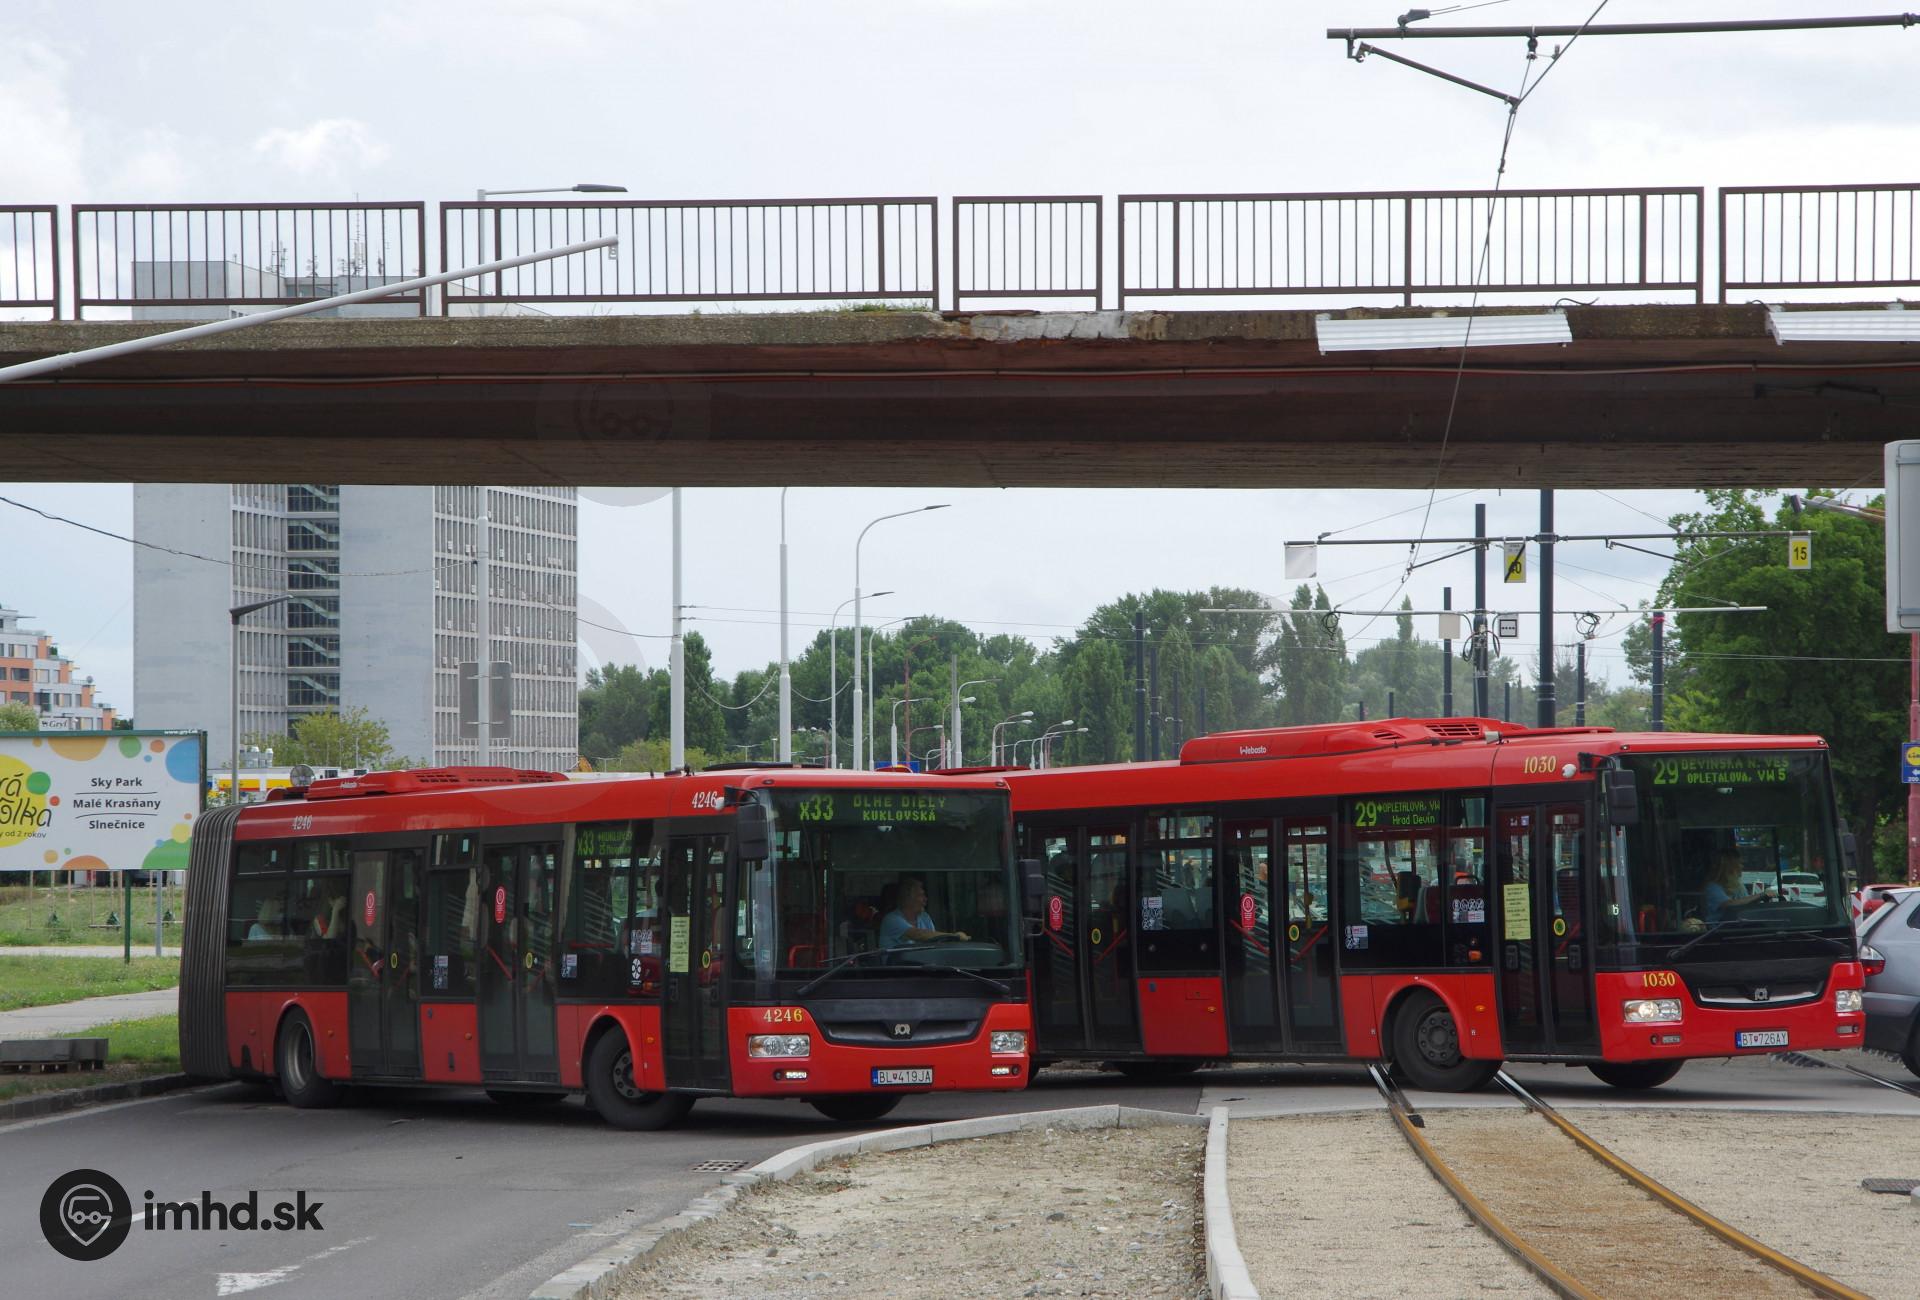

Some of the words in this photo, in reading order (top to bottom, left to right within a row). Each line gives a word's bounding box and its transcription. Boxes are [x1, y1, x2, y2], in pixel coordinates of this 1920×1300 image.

[1793, 546, 1808, 561] 15
[1524, 755, 1557, 774] 1030
[1654, 759, 1679, 785] 29
[90, 777, 112, 789] Sky
[115, 777, 143, 787] Park
[73, 799, 102, 808] Malé
[105, 798, 161, 810] Krasňany
[691, 791, 718, 809] 4246
[1355, 801, 1377, 827] 29
[1392, 814, 1411, 825] Hrad
[88, 820, 145, 829] Slnečnice
[1642, 972, 1676, 987] 1030
[763, 1008, 803, 1023] 4246
